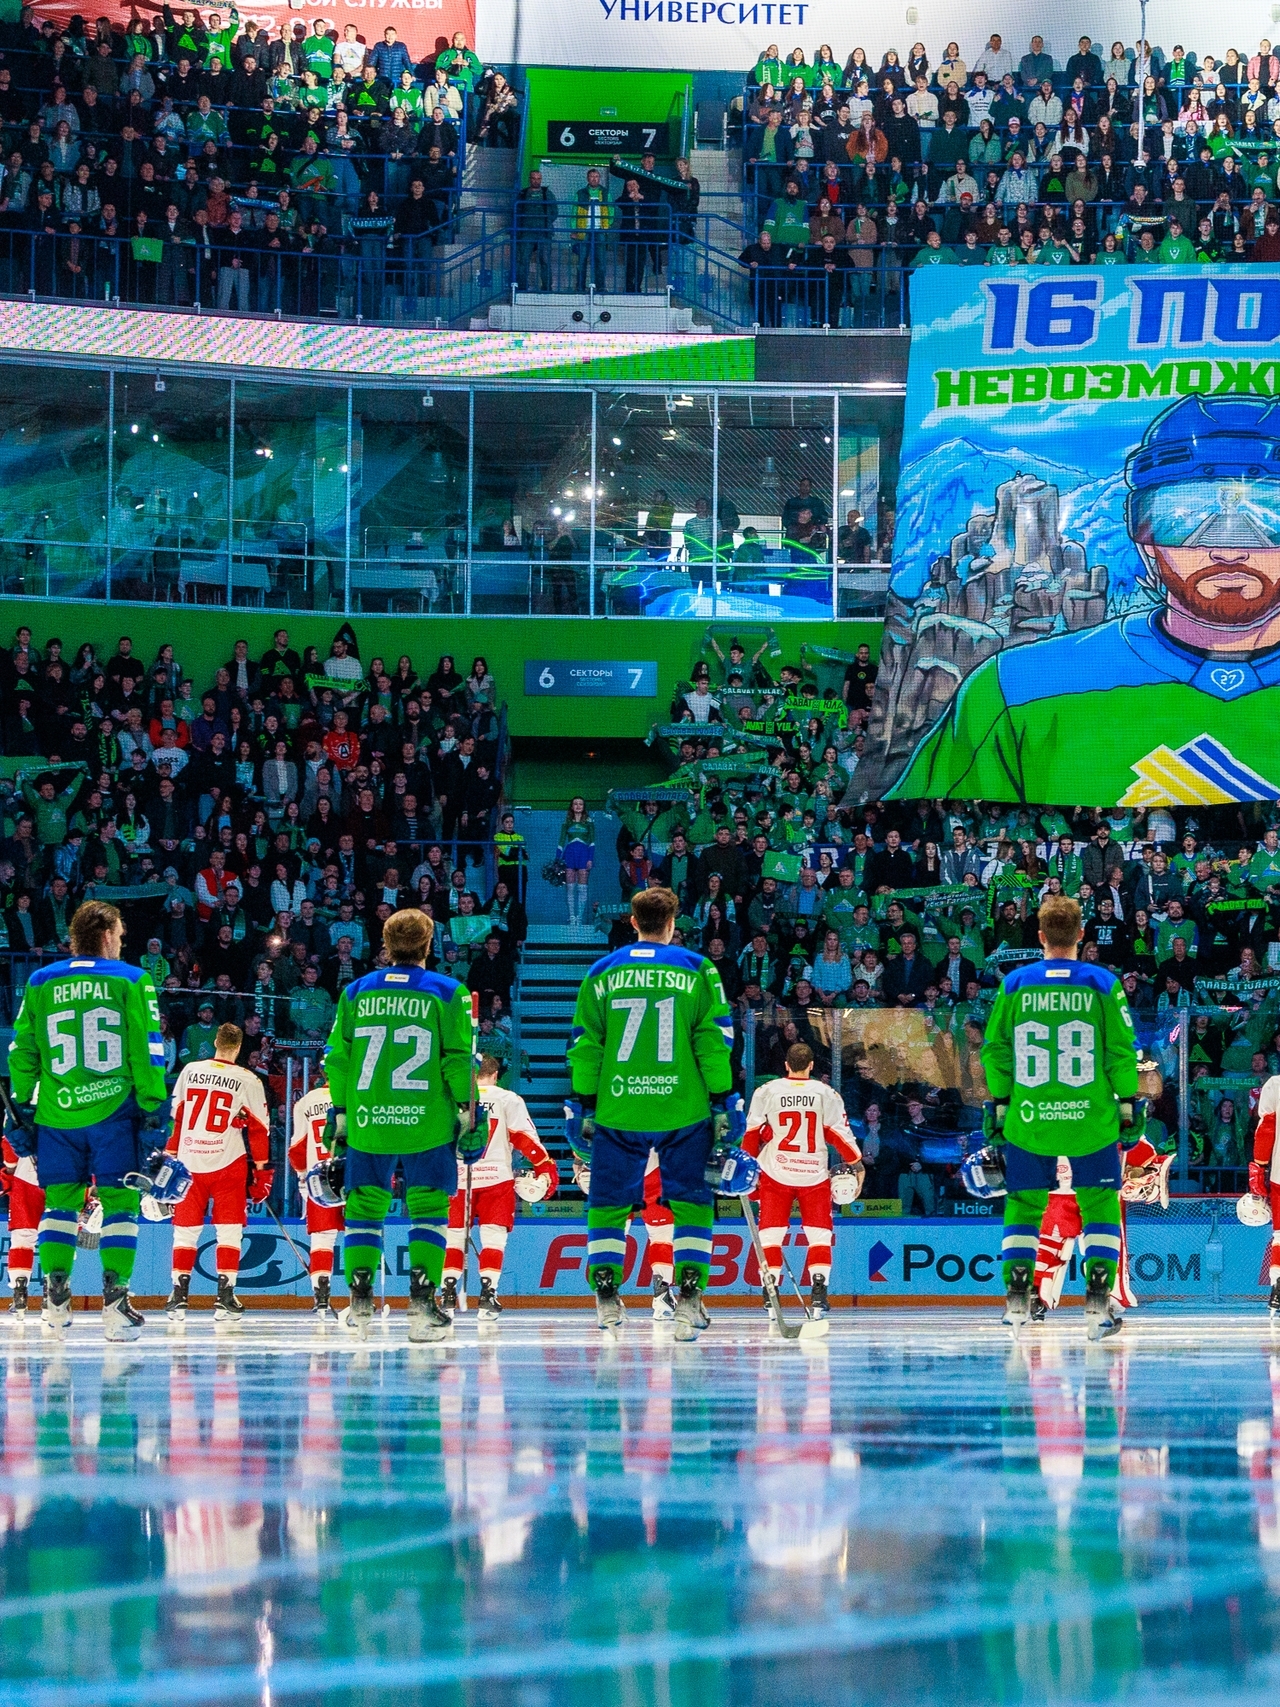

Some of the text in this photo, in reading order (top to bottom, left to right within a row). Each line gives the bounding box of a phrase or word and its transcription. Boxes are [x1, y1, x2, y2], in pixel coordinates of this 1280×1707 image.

[601, 0, 809, 25] УНИВЕРСИТЕТ
[560, 127, 657, 148] 6 СЕКТОРЫ 7
[985, 280, 1098, 350] 16
[539, 667, 643, 689] 6 СЕКТОРЫ 7
[1220, 674, 1237, 686] 27
[53, 980, 113, 1004] REMPAL
[1021, 992, 1094, 1012] PIMENOV
[147, 1000, 160, 1021] 5
[357, 995, 432, 1019] SUCHKOV
[611, 996, 675, 1062] 71
[46, 1005, 123, 1076] 56
[353, 1024, 432, 1091] 72
[1014, 1019, 1095, 1088] 68
[187, 1069, 242, 1093] KASHTANOV
[627, 1075, 679, 1086] САДОВОЕ
[627, 1085, 673, 1095] КОЛЬЦО
[76, 1084, 123, 1104] КОЛЬЦО
[780, 1094, 816, 1108] OSIPOV
[186, 1087, 234, 1135] 76
[371, 1105, 426, 1115] САДОВОЕ
[1038, 1099, 1091, 1111] САДОВОЕ
[1038, 1110, 1086, 1121] КОЛЬЦО
[371, 1115, 419, 1126] КОЛЬЦО
[778, 1110, 817, 1154] 21
[866, 1203, 893, 1213] БАНК
[954, 1203, 993, 1215] Haier
